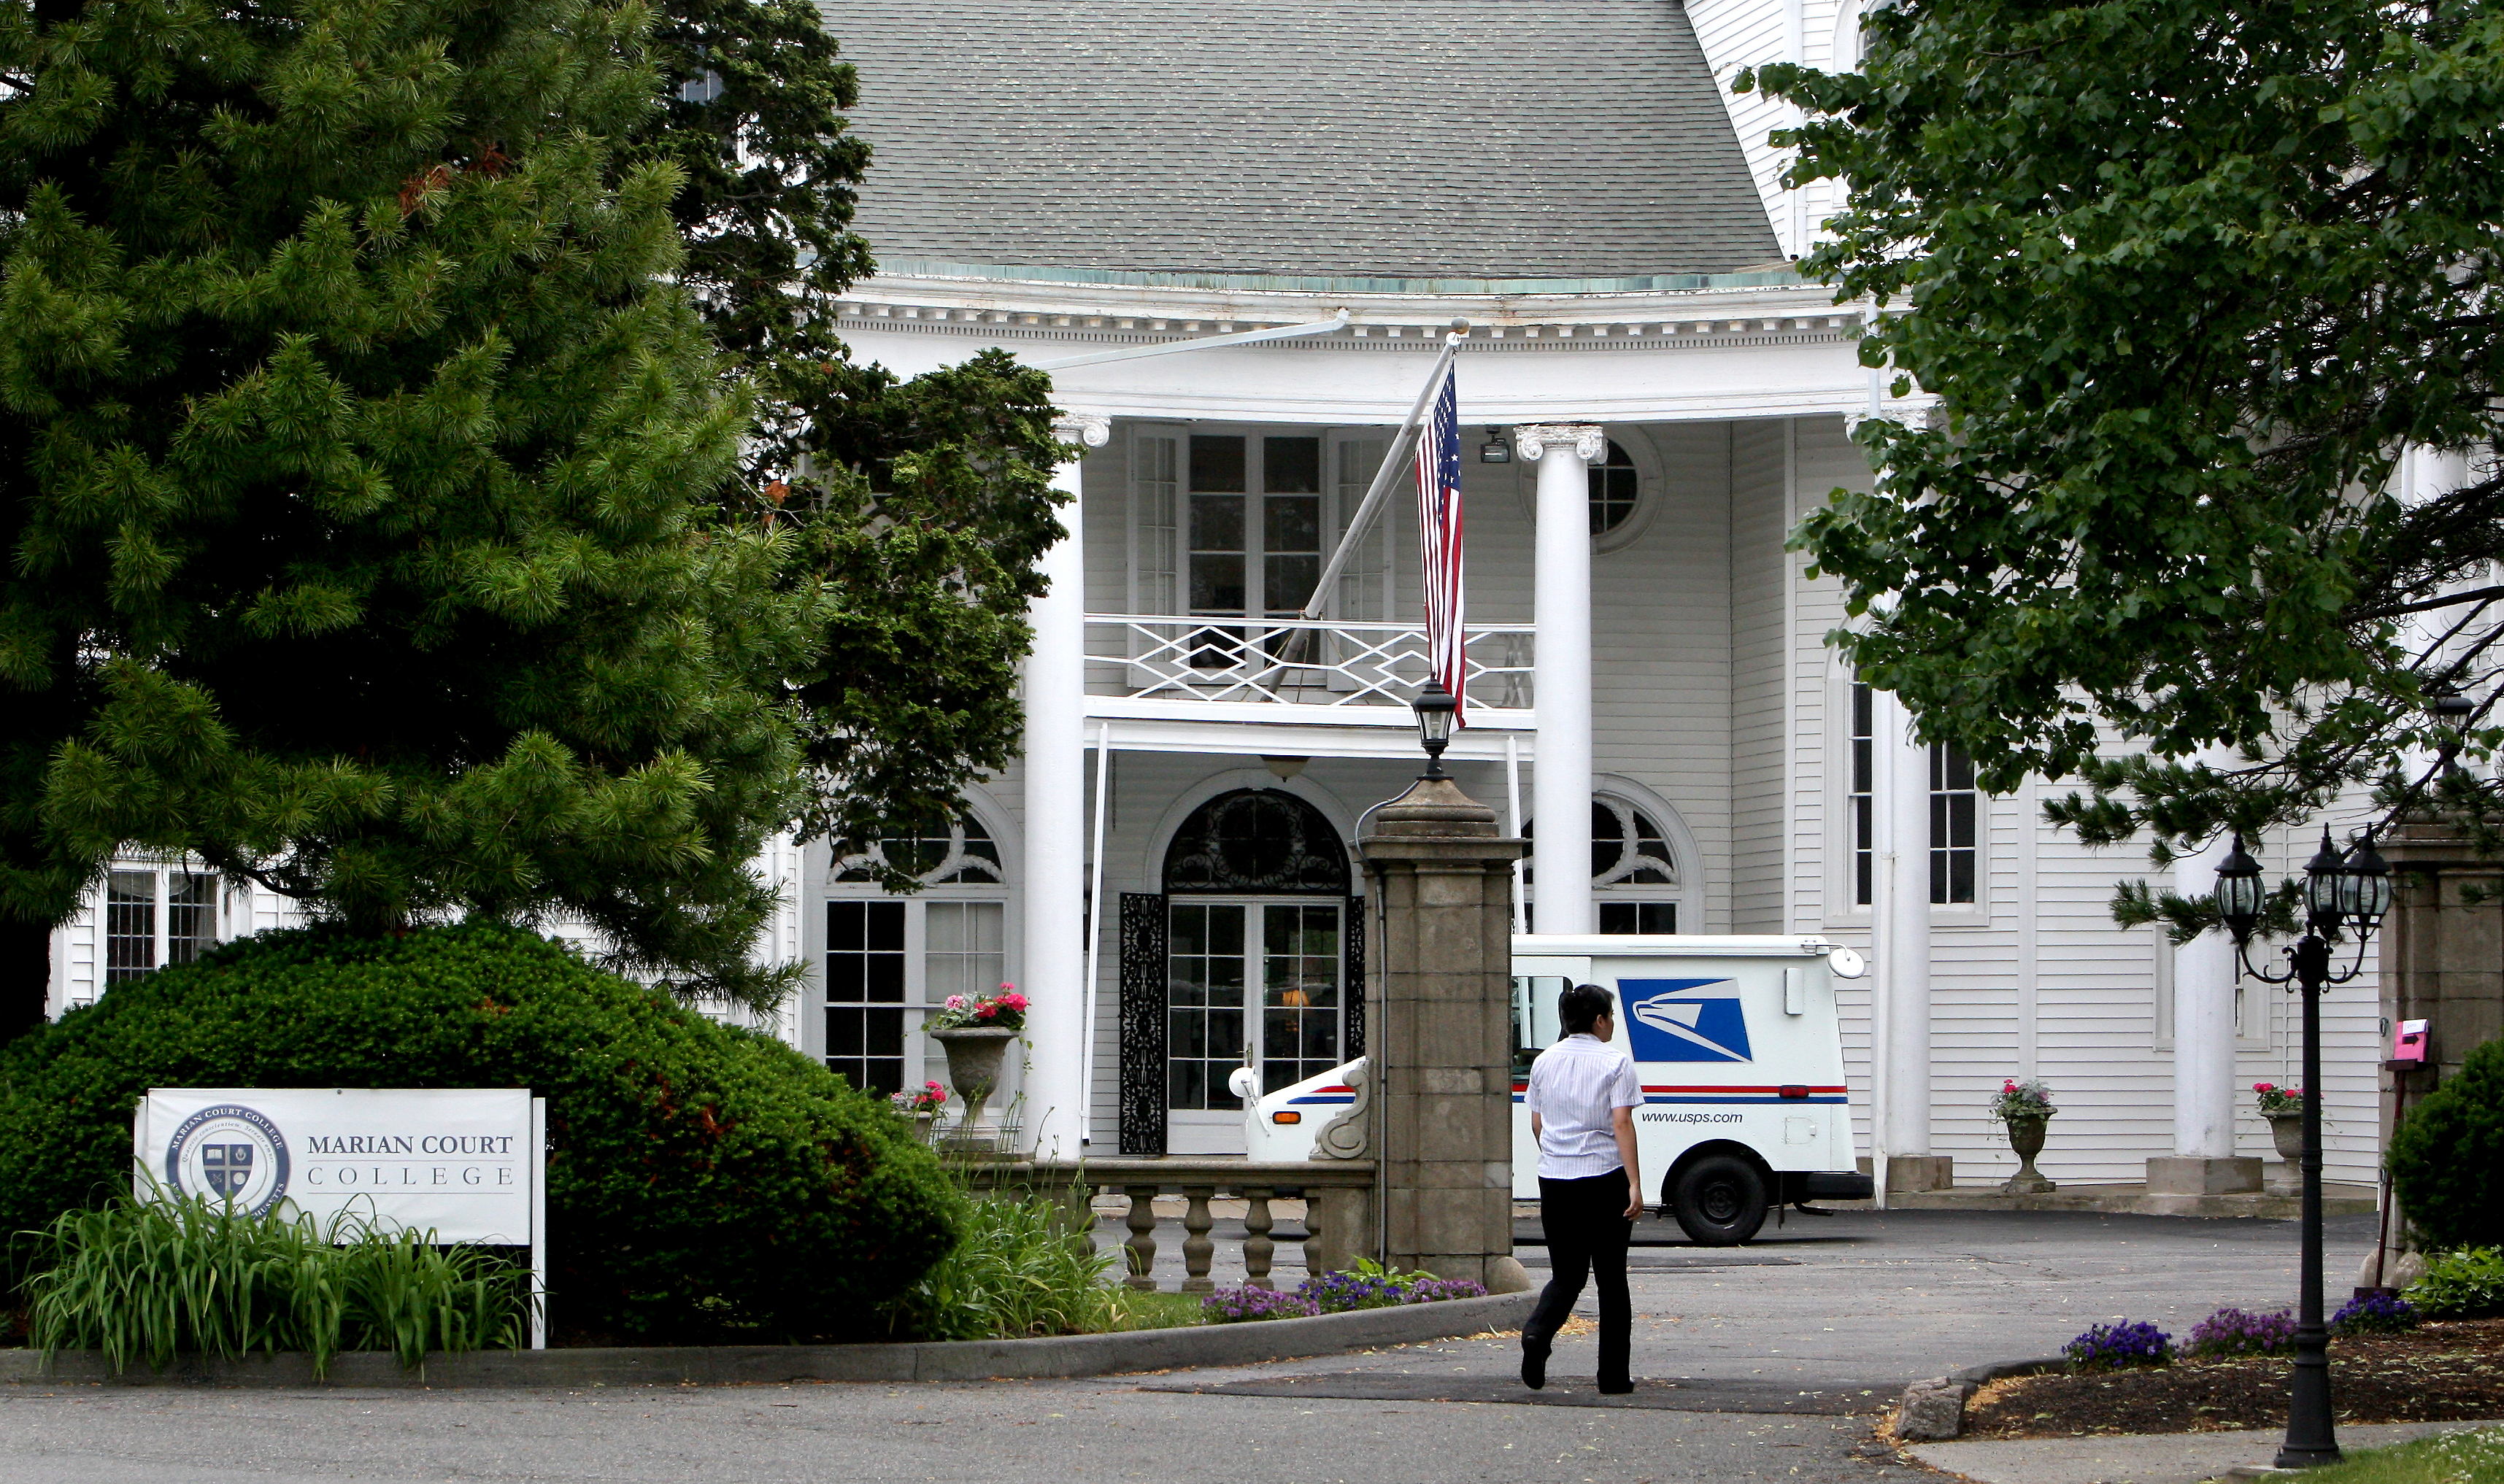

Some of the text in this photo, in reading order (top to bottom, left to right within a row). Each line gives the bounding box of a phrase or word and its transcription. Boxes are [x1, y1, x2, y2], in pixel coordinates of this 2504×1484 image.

[1642, 1113, 1743, 1125] www.usps.com
[172, 1108, 283, 1150] MARIAN COURT COLLEGE
[307, 1136, 514, 1153] MARIAN COURT
[307, 1167, 514, 1186] COLLEGE
